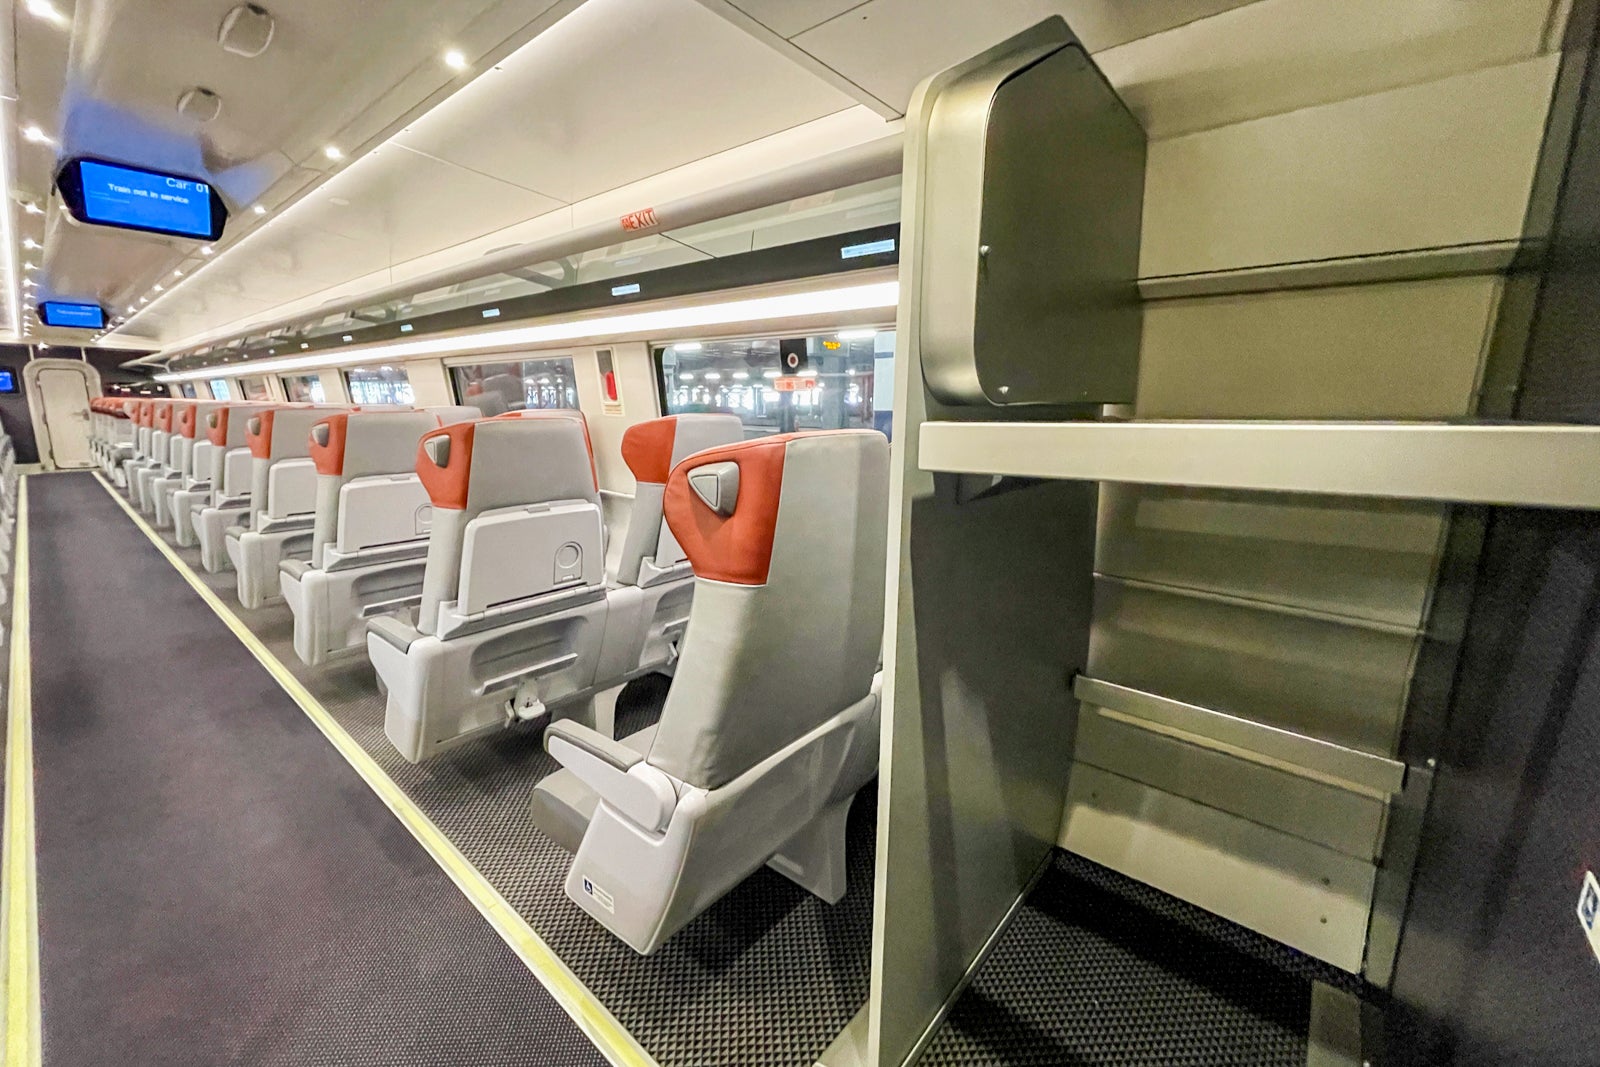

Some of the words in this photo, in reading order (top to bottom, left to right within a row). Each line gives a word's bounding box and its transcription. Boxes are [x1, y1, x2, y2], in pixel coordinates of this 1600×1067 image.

[108, 183, 131, 195] Train
[133, 188, 148, 197] not
[161, 193, 189, 204] service
[166, 178, 191, 191] Car:
[196, 183, 209, 193] 01
[628, 209, 655, 229] EXIT
